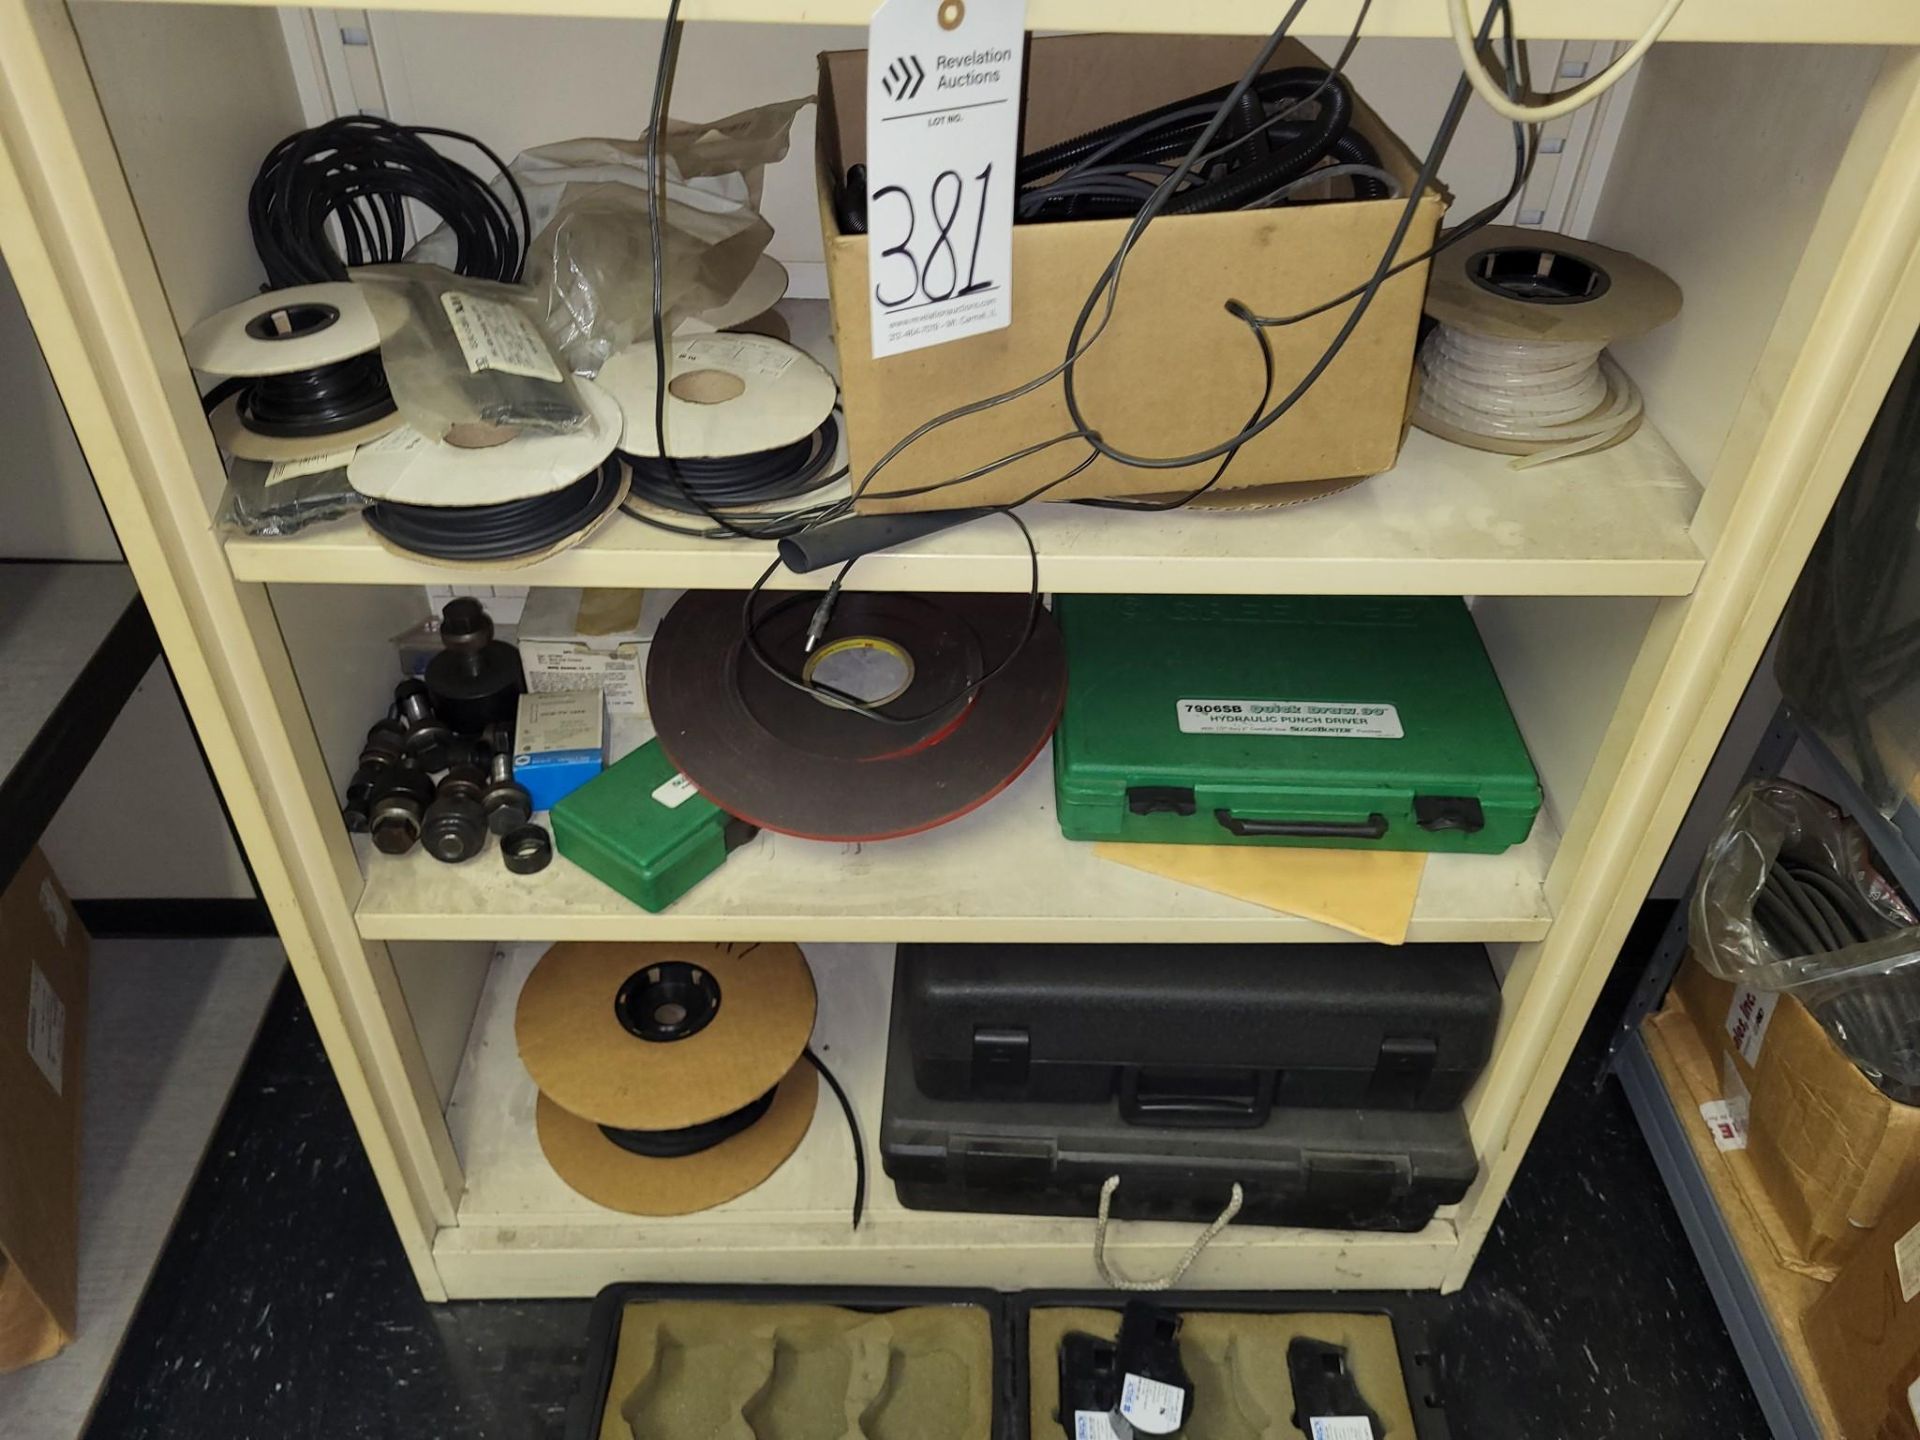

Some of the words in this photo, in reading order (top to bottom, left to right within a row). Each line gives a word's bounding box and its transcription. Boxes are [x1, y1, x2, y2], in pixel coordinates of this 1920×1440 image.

[936, 47, 1012, 71] Revelation
[936, 69, 1001, 91] Auctions
[927, 116, 945, 128] LOT
[872, 161, 993, 308] 381
[1184, 704, 1243, 714] 7906SB
[1249, 703, 1302, 714] Quick
[1209, 715, 1278, 724] HYDRAULIC
[1281, 716, 1322, 724] PUNCH
[1325, 717, 1369, 725] DRIVER
